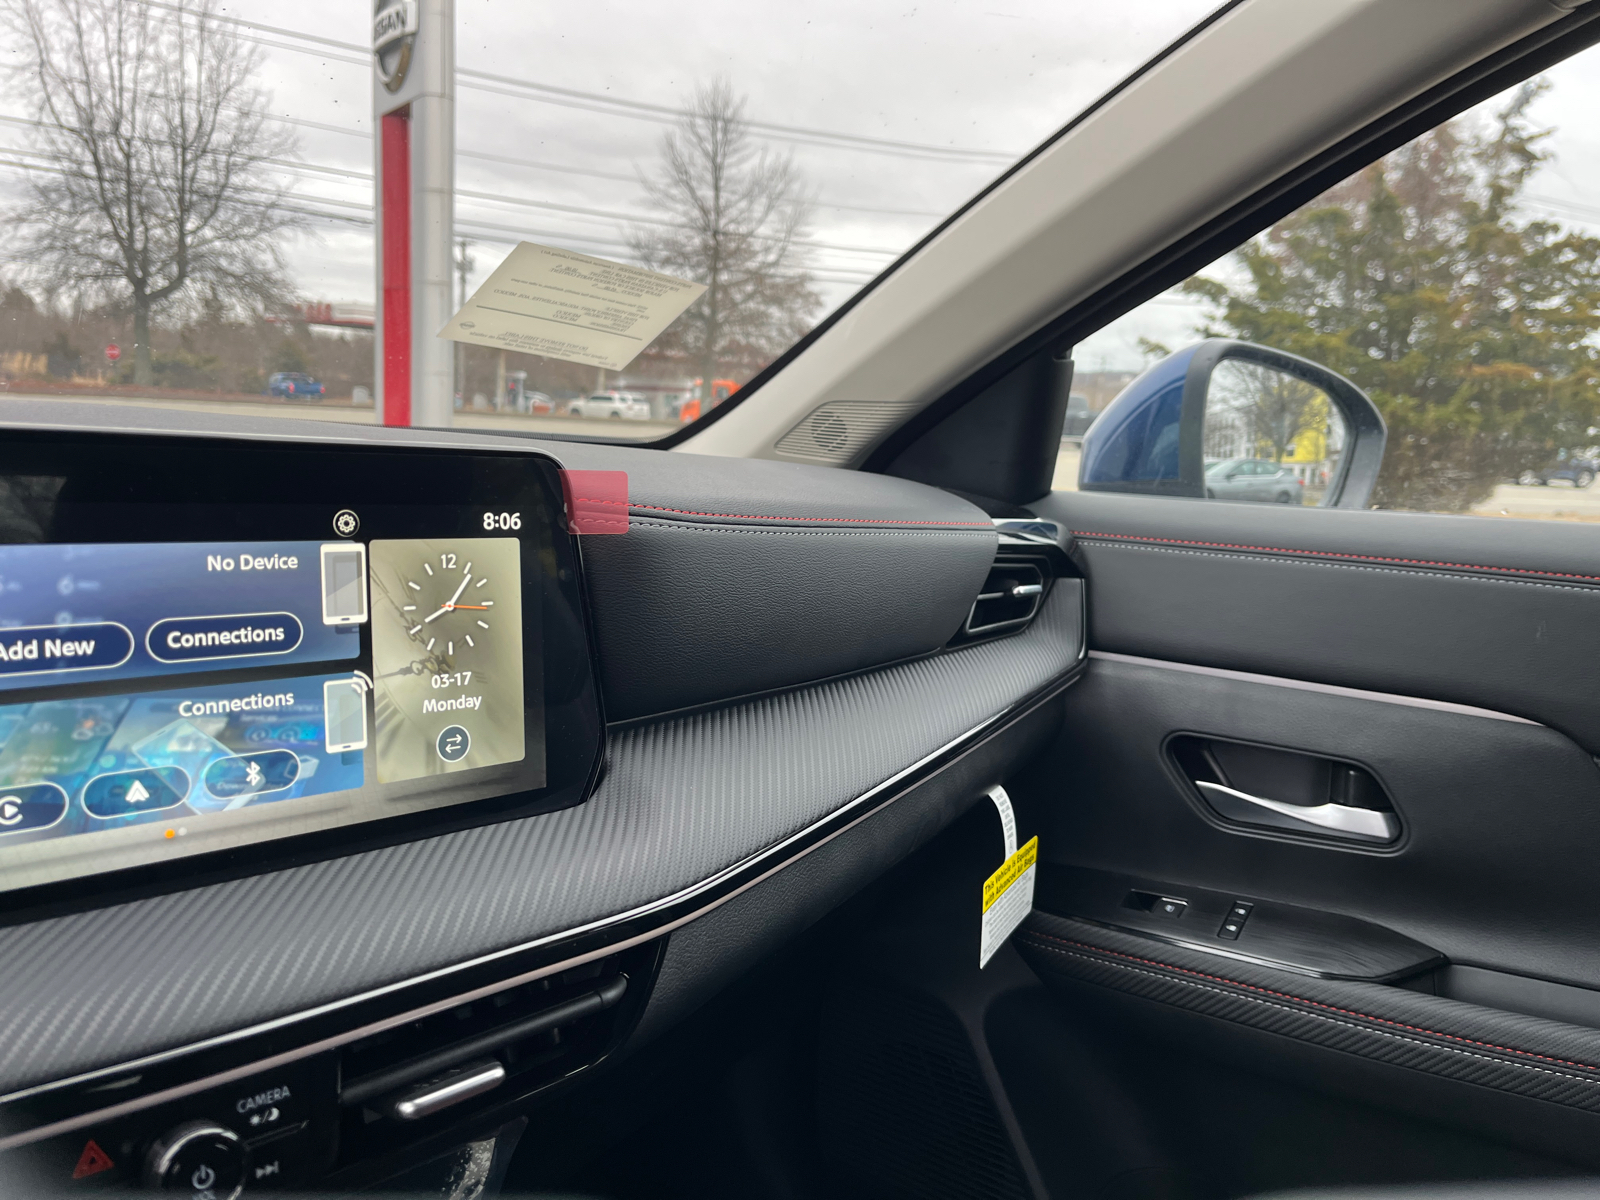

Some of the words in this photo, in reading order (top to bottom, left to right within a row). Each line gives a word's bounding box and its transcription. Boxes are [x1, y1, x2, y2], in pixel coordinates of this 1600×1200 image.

[483, 512, 521, 530] 8:06
[207, 554, 235, 571] No
[240, 554, 299, 570] Device
[440, 553, 457, 569] 12
[166, 626, 285, 649] Connections
[44, 638, 96, 658] New
[431, 671, 472, 689] 03-17
[178, 693, 294, 717] Connections
[422, 694, 482, 714] Monday
[236, 1085, 291, 1113] CAMERA
